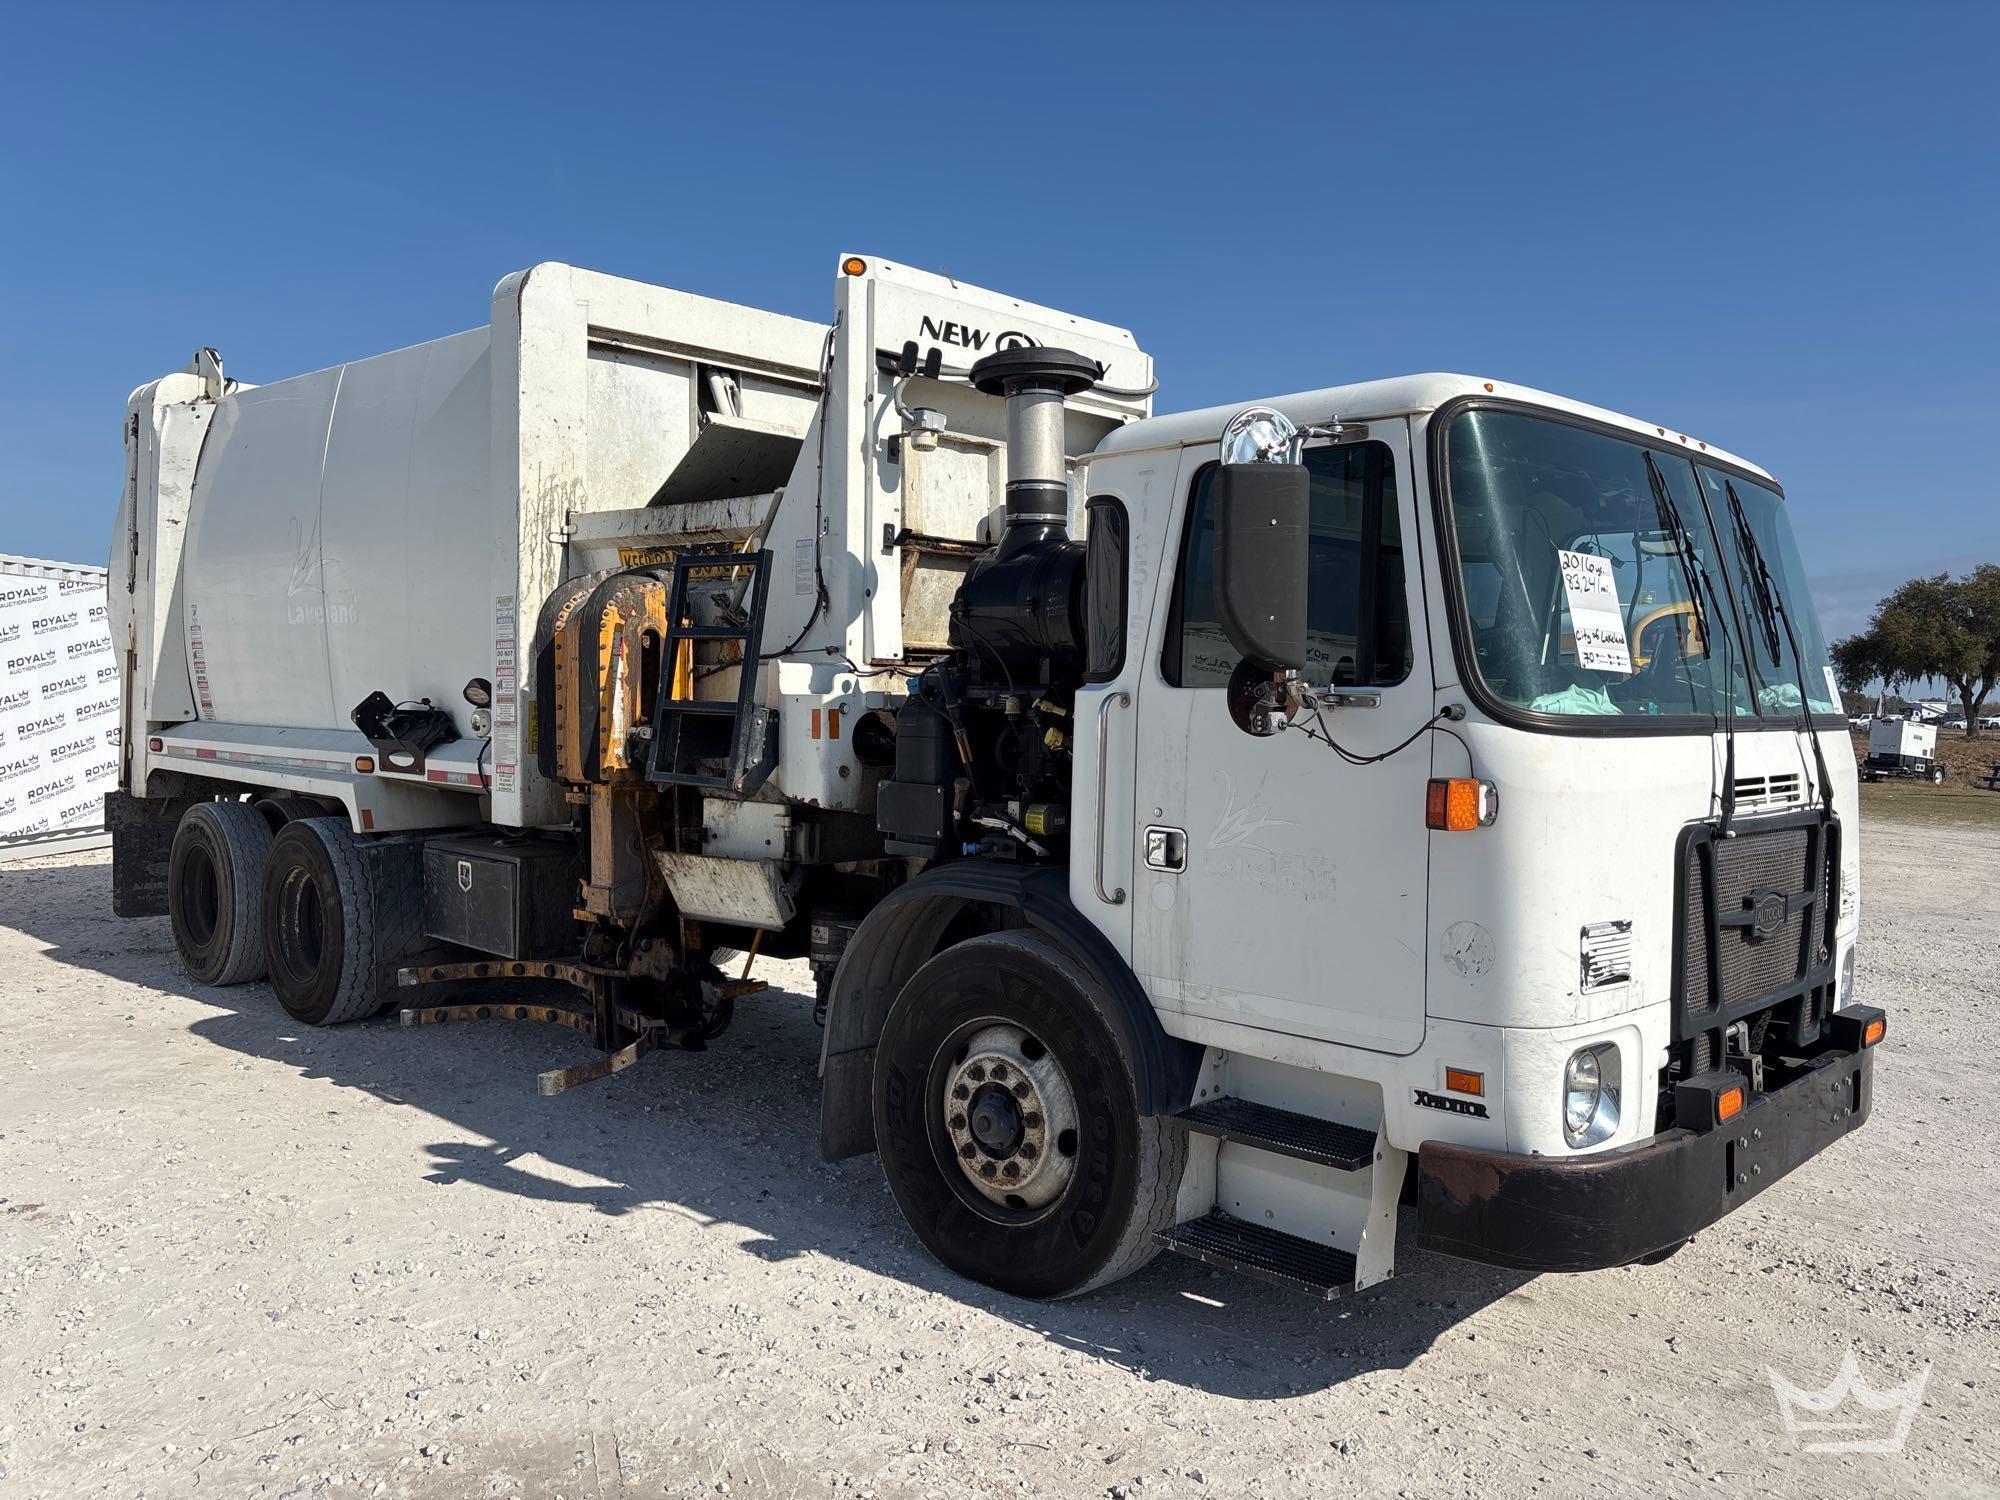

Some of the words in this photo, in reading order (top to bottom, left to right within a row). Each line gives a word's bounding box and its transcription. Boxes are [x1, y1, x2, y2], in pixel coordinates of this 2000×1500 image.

[919, 315, 991, 351] NEW
[1562, 552, 1595, 572] 2016
[1565, 573, 1600, 595] 83,241
[0, 587, 38, 601] ROYAL
[28, 594, 48, 603] GROUP
[32, 615, 68, 630] ROYAL
[34, 626, 59, 636] AUCTION
[59, 621, 79, 630] GROUP
[67, 639, 102, 654] ROYAL
[69, 649, 93, 660] AUCTION
[7, 652, 47, 669] ROYAL
[9, 664, 37, 675] AUCTION
[37, 659, 57, 669] GROUP
[42, 677, 77, 694] ROYAL
[44, 689, 68, 700] AUCTION
[69, 683, 88, 693] GROUP
[9, 700, 31, 710] GROUP
[76, 700, 111, 716] ROYAL
[78, 711, 102, 722] AUCTION
[18, 716, 56, 734] ROYAL
[20, 729, 46, 741] AUCTION
[50, 739, 87, 757] ROYAL
[53, 751, 77, 763] AUCTION
[0, 759, 29, 775] OYAL
[19, 764, 41, 775] GROUP
[85, 760, 119, 777] ROYAL
[28, 779, 65, 799] ROYAL
[30, 791, 55, 805] AUCTION
[56, 784, 76, 795] GROUP
[60, 800, 96, 819] ROYAL
